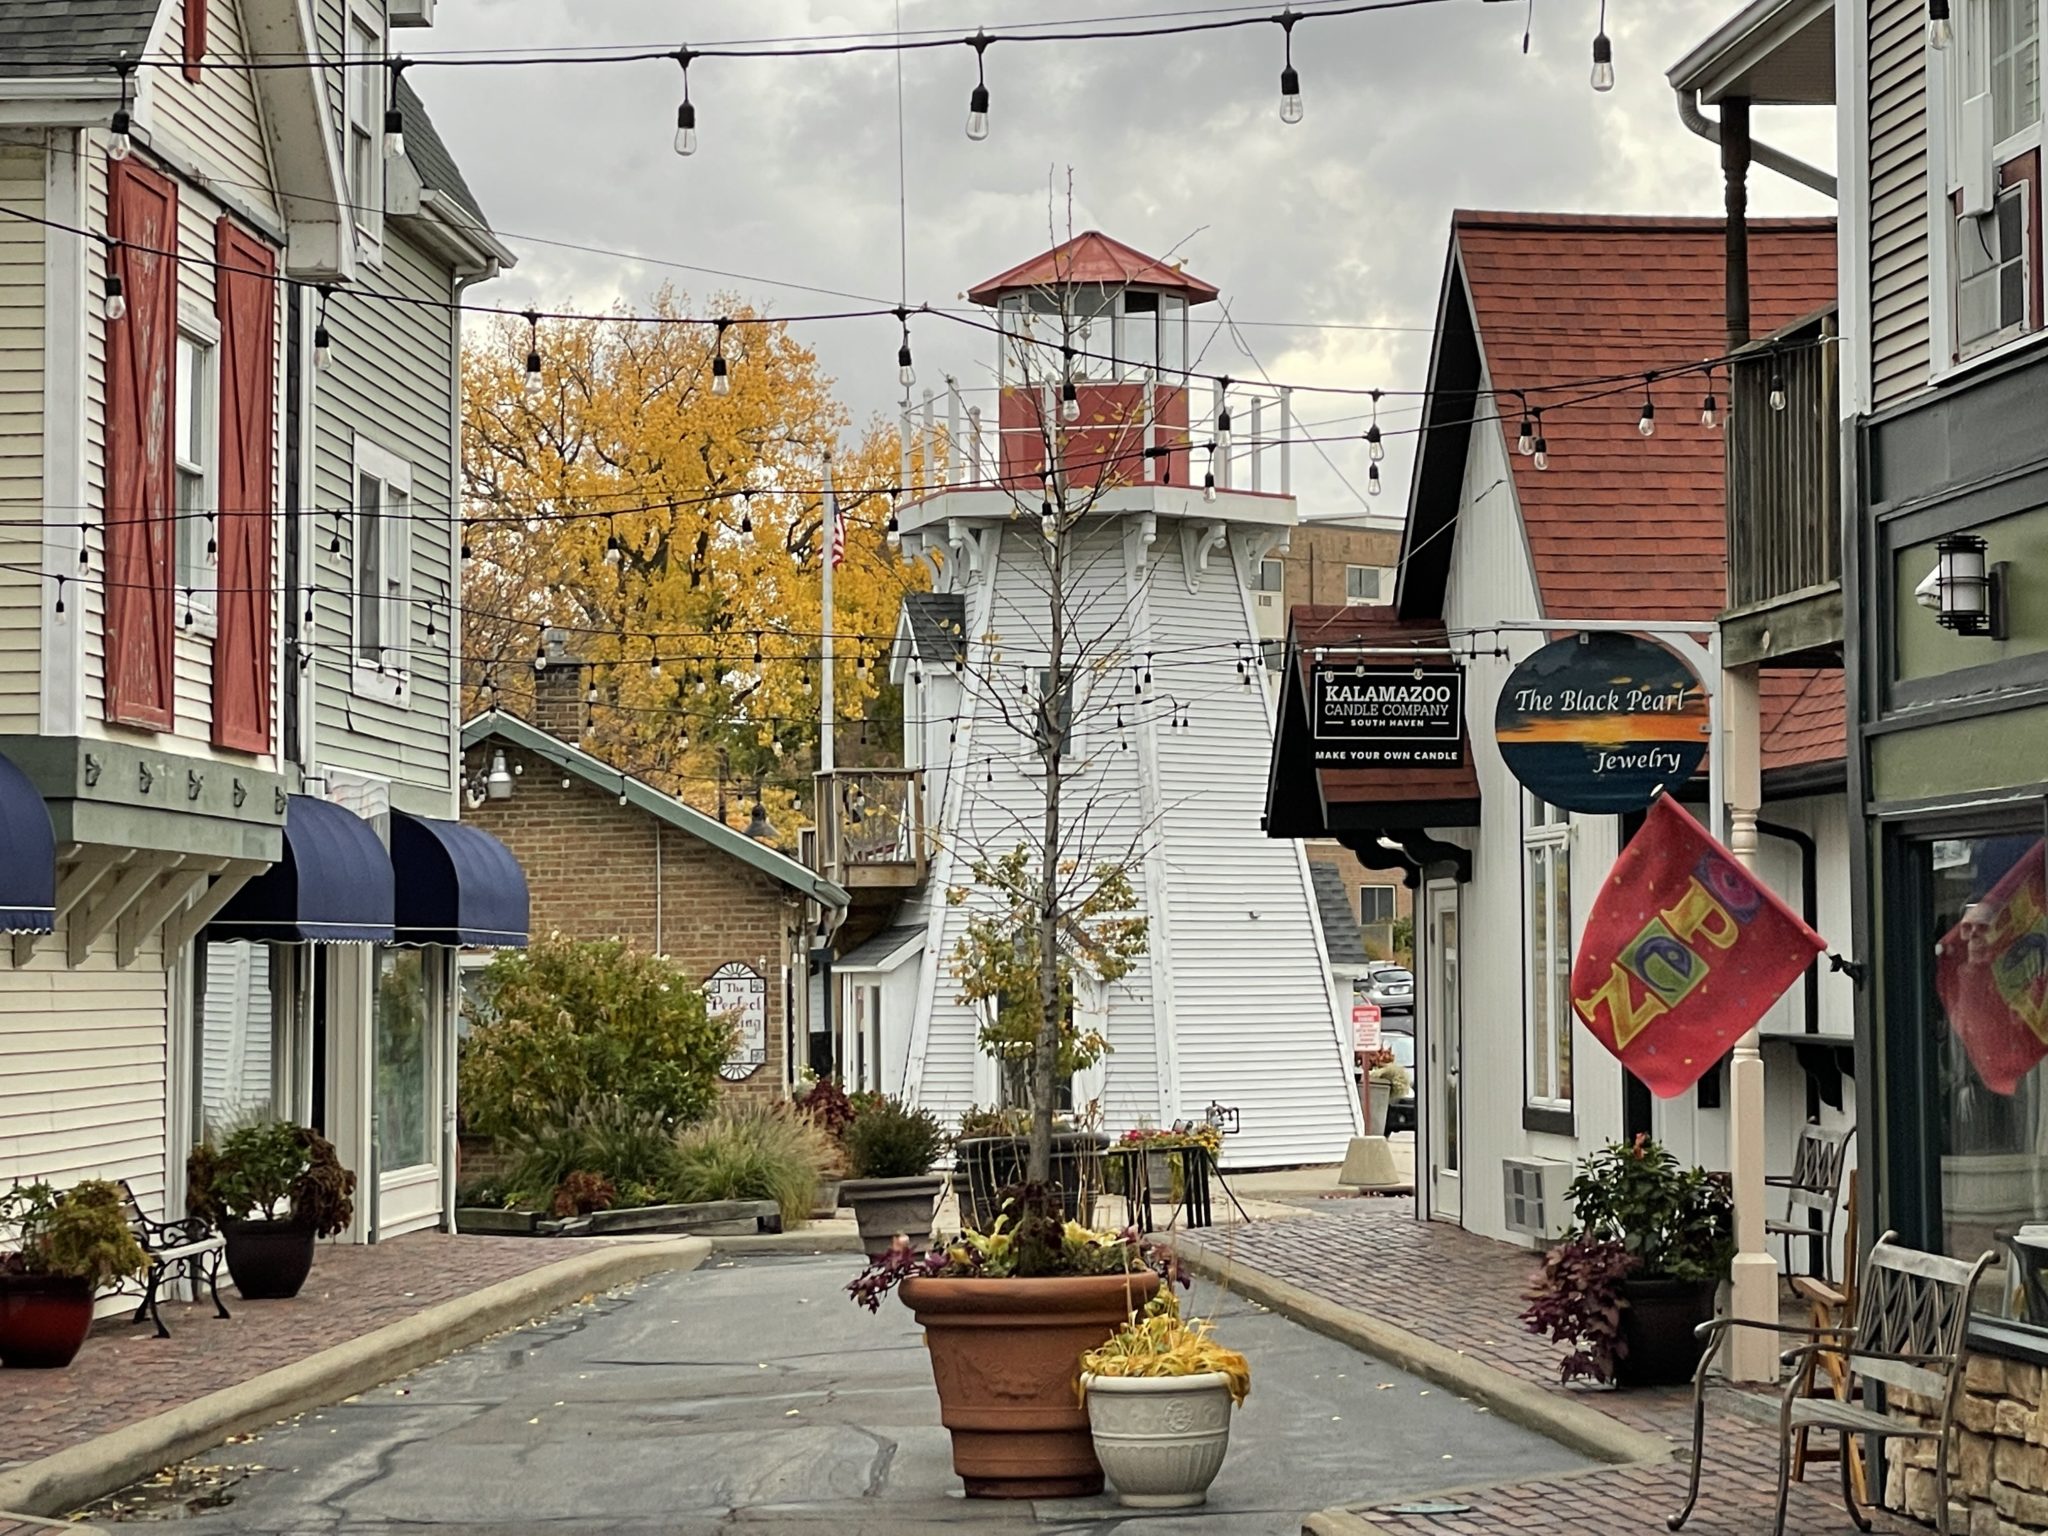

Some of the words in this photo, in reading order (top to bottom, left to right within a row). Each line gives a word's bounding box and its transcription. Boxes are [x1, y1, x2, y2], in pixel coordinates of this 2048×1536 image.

[1325, 686, 1451, 702] KALAMAZOO
[1515, 688, 1553, 712] The
[1560, 688, 1620, 712] Black
[1626, 688, 1686, 712] Pearl
[1324, 704, 1379, 716] CANDLE
[1382, 704, 1449, 716] COMPANY
[1350, 719, 1386, 727] SOUTH
[1389, 719, 1425, 727] HAVEN
[1315, 751, 1346, 760] MAKE
[1350, 751, 1380, 760] YOUR
[1384, 751, 1411, 760] OWN
[1414, 751, 1458, 760] CANDLE
[1592, 747, 1682, 773] Jewelry
[724, 982, 745, 993] The
[710, 996, 761, 1011] Perfct
